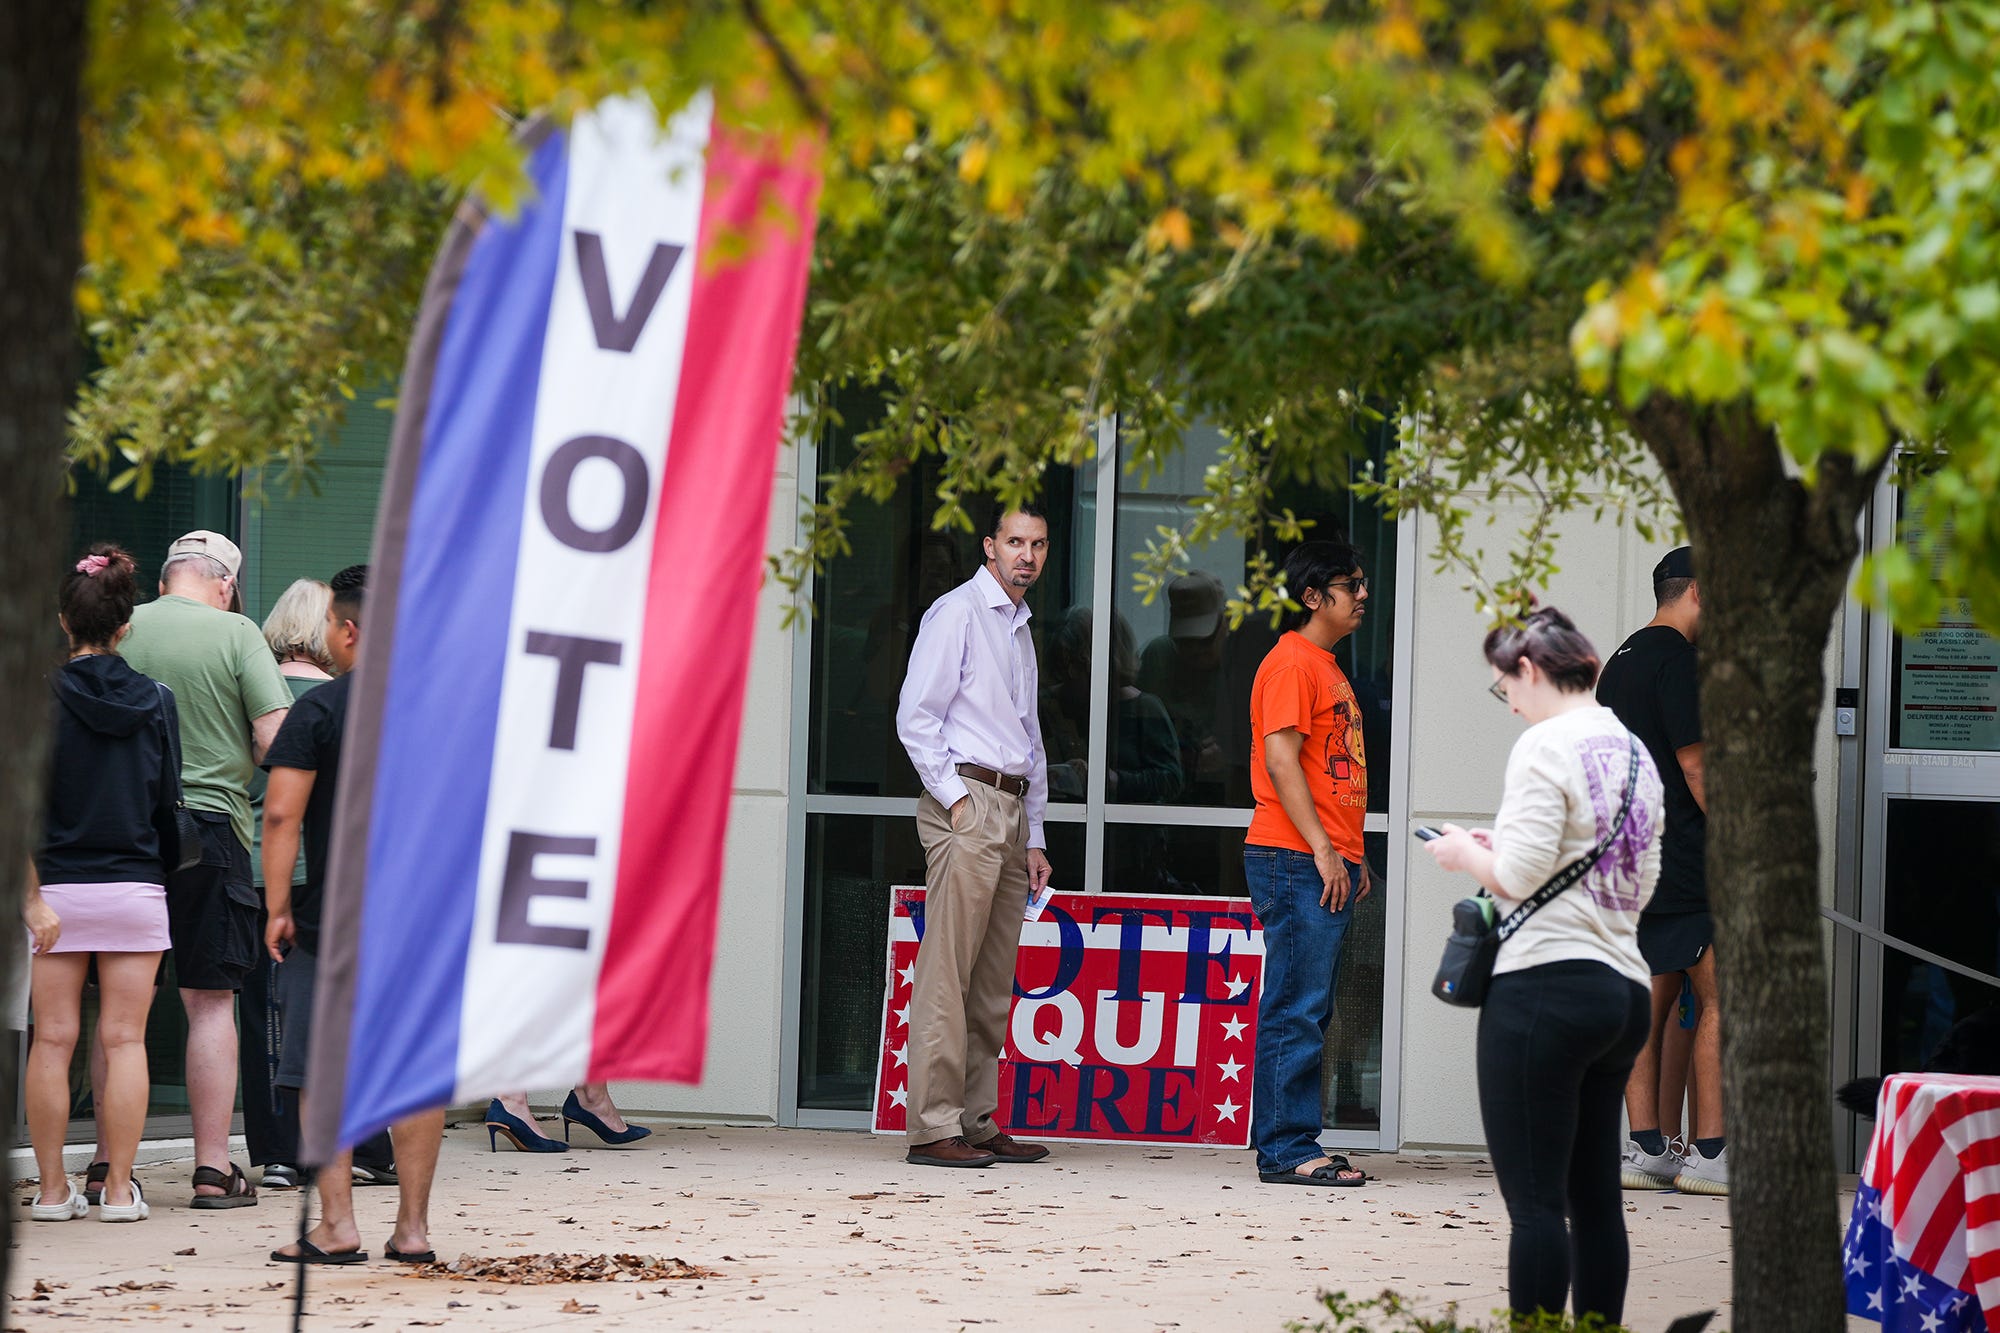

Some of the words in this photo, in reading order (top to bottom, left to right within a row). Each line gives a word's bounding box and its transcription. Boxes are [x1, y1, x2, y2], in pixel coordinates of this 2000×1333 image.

[495, 230, 685, 950] VOTE
[1939, 638, 1979, 646] ASSISTANCE
[1955, 631, 1974, 639] DOOR
[1884, 754, 1919, 766] CAUTION
[1922, 755, 1949, 767] STAND
[1952, 756, 1975, 768] BACK
[902, 901, 1255, 1006] OTE
[998, 986, 1201, 1069] QUI
[998, 1061, 1197, 1136] ERE
